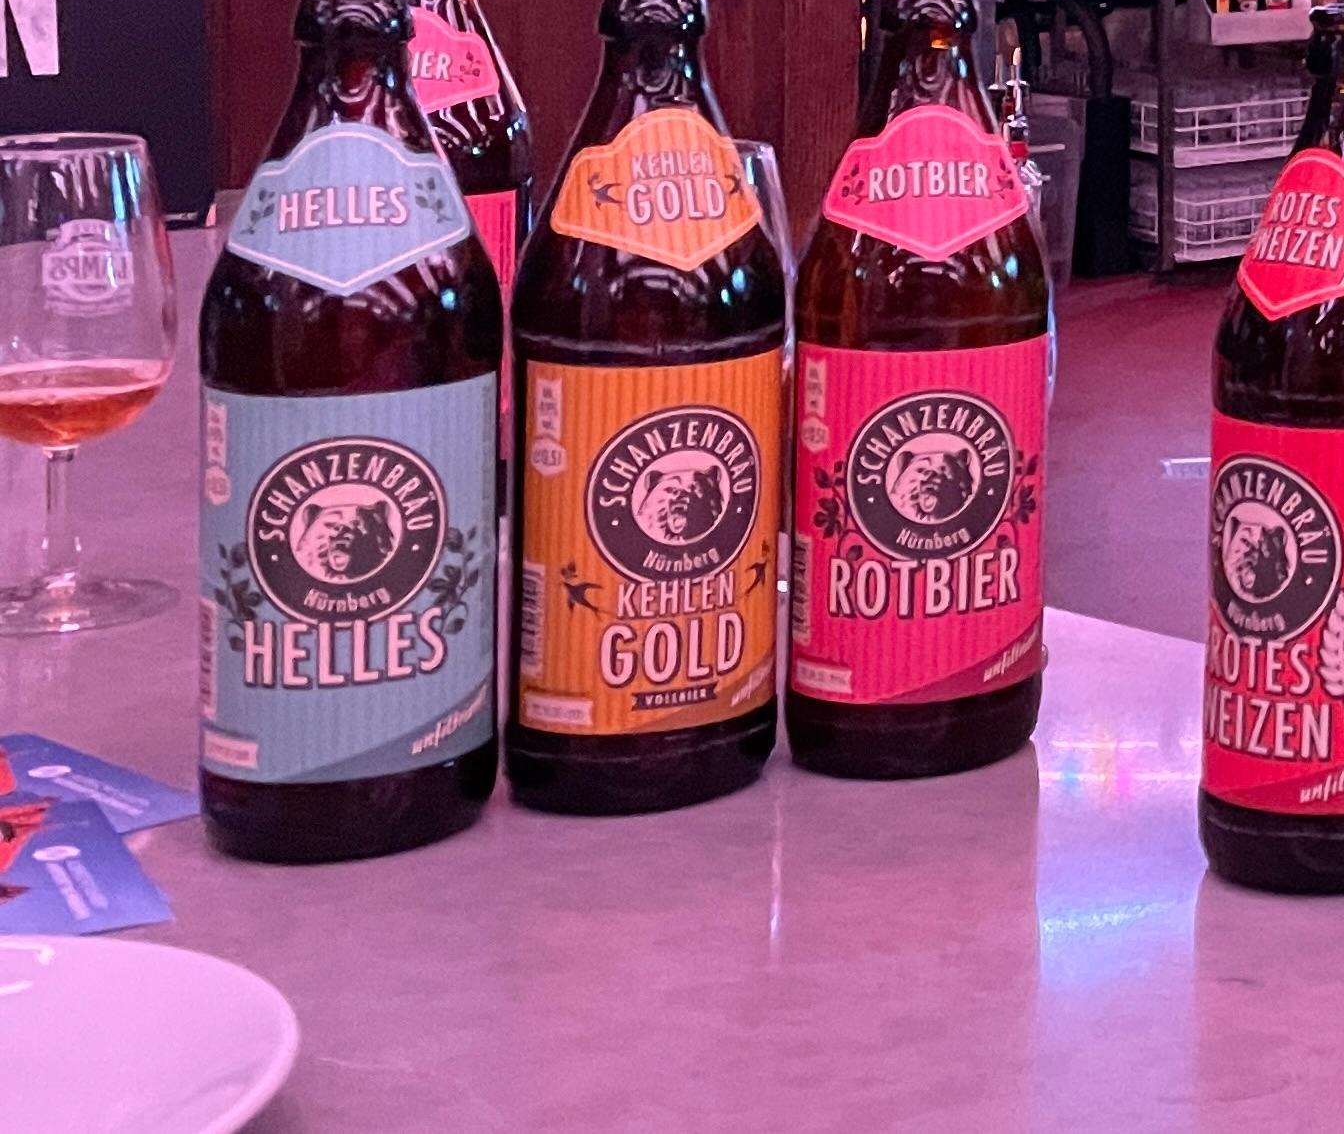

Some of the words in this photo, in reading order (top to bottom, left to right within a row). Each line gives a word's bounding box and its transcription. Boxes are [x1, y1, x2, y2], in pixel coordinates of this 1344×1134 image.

[630, 149, 715, 179] KEHLEN
[868, 160, 991, 203] ROTBIER
[278, 185, 411, 232] HELLES
[625, 178, 727, 226] GOLD
[1269, 191, 1342, 229] ROTES
[599, 418, 754, 509] SCHANZENBRÄU
[855, 400, 1006, 487] SCHANZENBRÄU
[258, 451, 436, 543] SCHANZENBRÄU
[642, 546, 720, 574] Nürnberg
[895, 526, 971, 551] Nürnberg
[303, 586, 392, 614] Nürnberg
[616, 569, 737, 618] KEHLEN
[827, 546, 1022, 620] ROTBIER
[243, 606, 449, 690] HELLES
[599, 611, 745, 689] GOLD
[1206, 625, 1314, 697] ROTES
